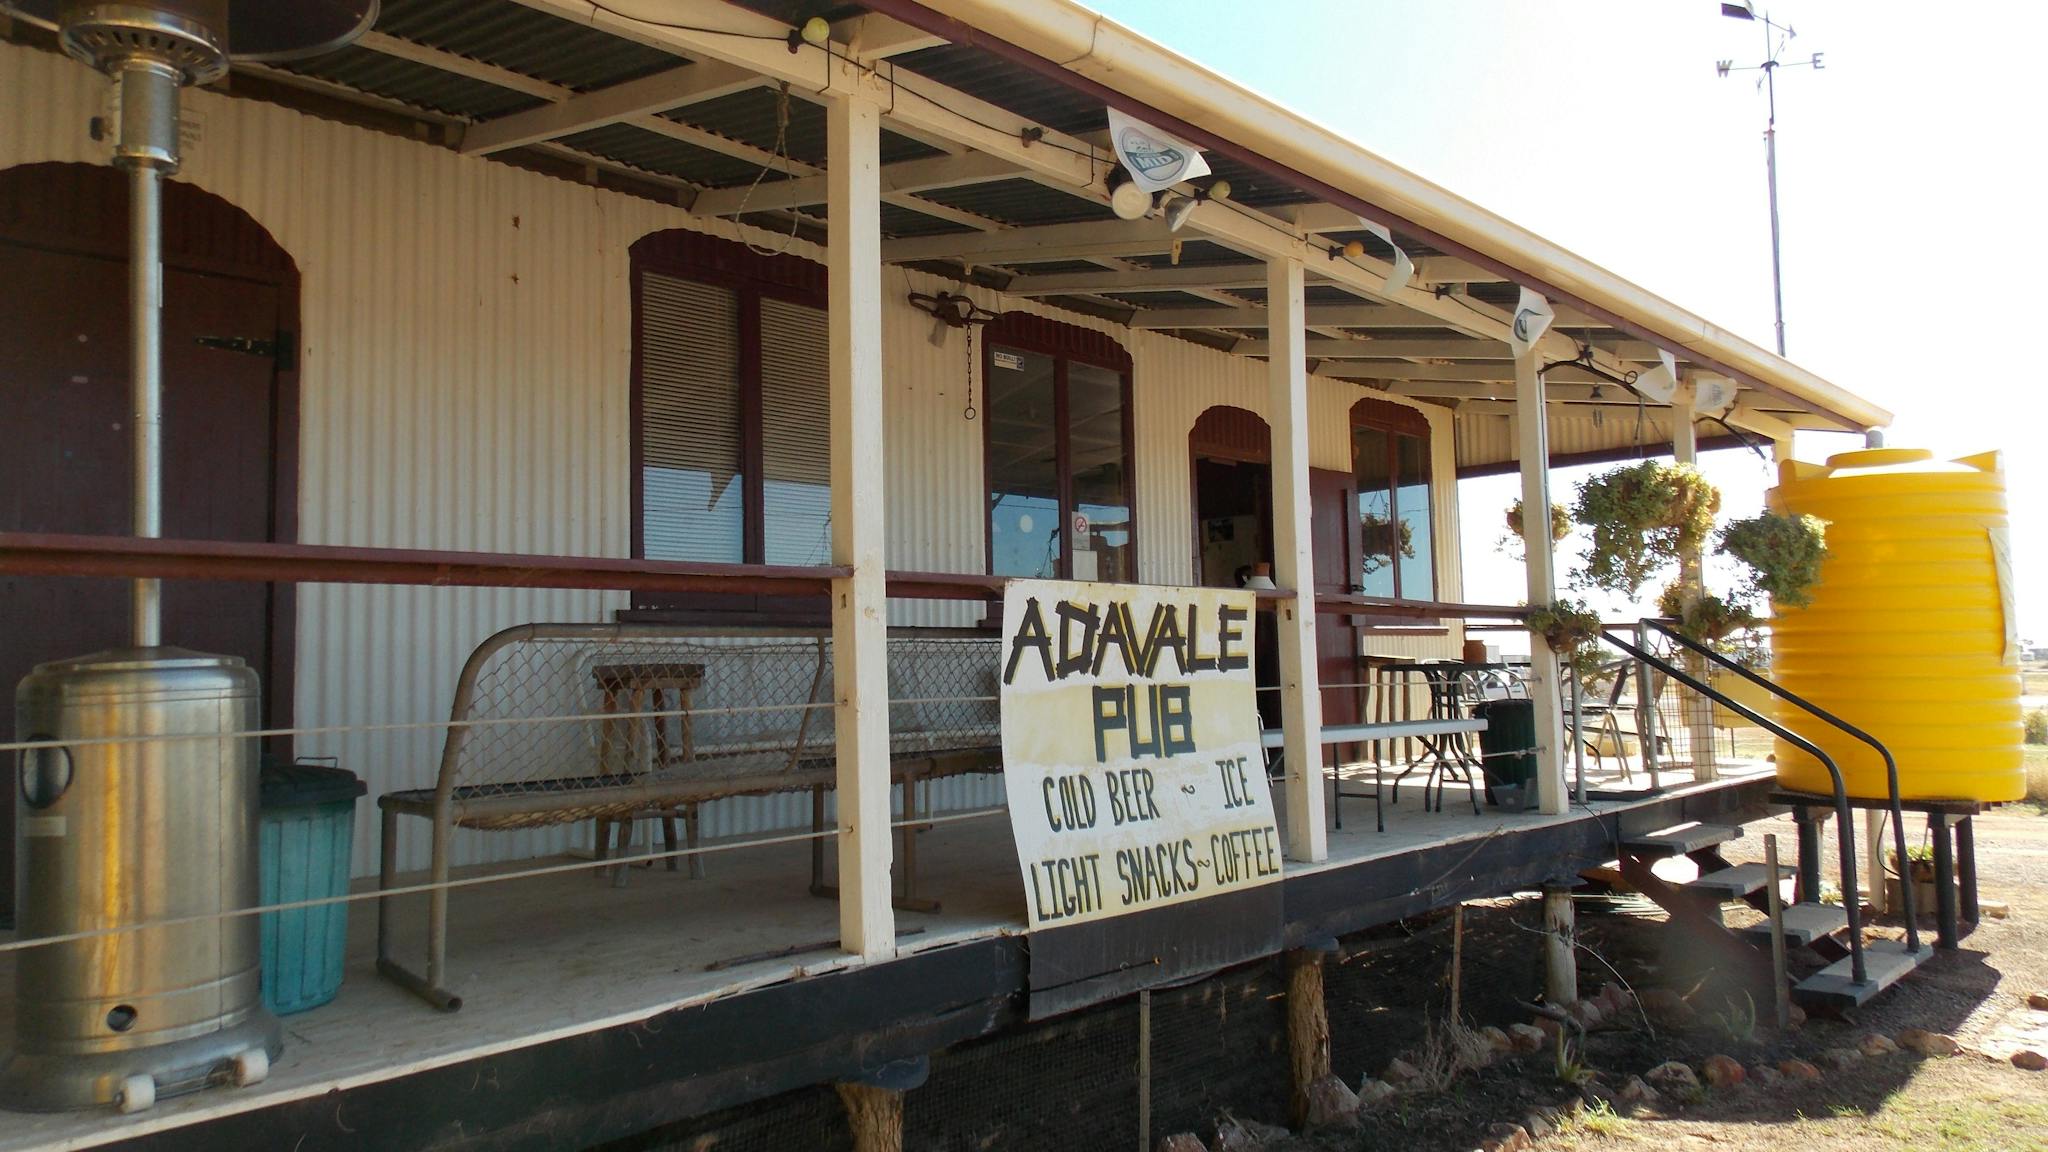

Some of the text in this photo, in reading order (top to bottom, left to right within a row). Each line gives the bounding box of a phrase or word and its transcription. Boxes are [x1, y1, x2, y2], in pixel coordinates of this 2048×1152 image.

[1716, 59, 1733, 78] W
[1812, 52, 1825, 69] E
[1003, 597, 1249, 684] ADAVALE
[1092, 684, 1196, 762] PUB
[1042, 757, 1255, 833] COLD BEER ICE
[1030, 826, 1279, 922] LIGHT SNACKS COFFEE
